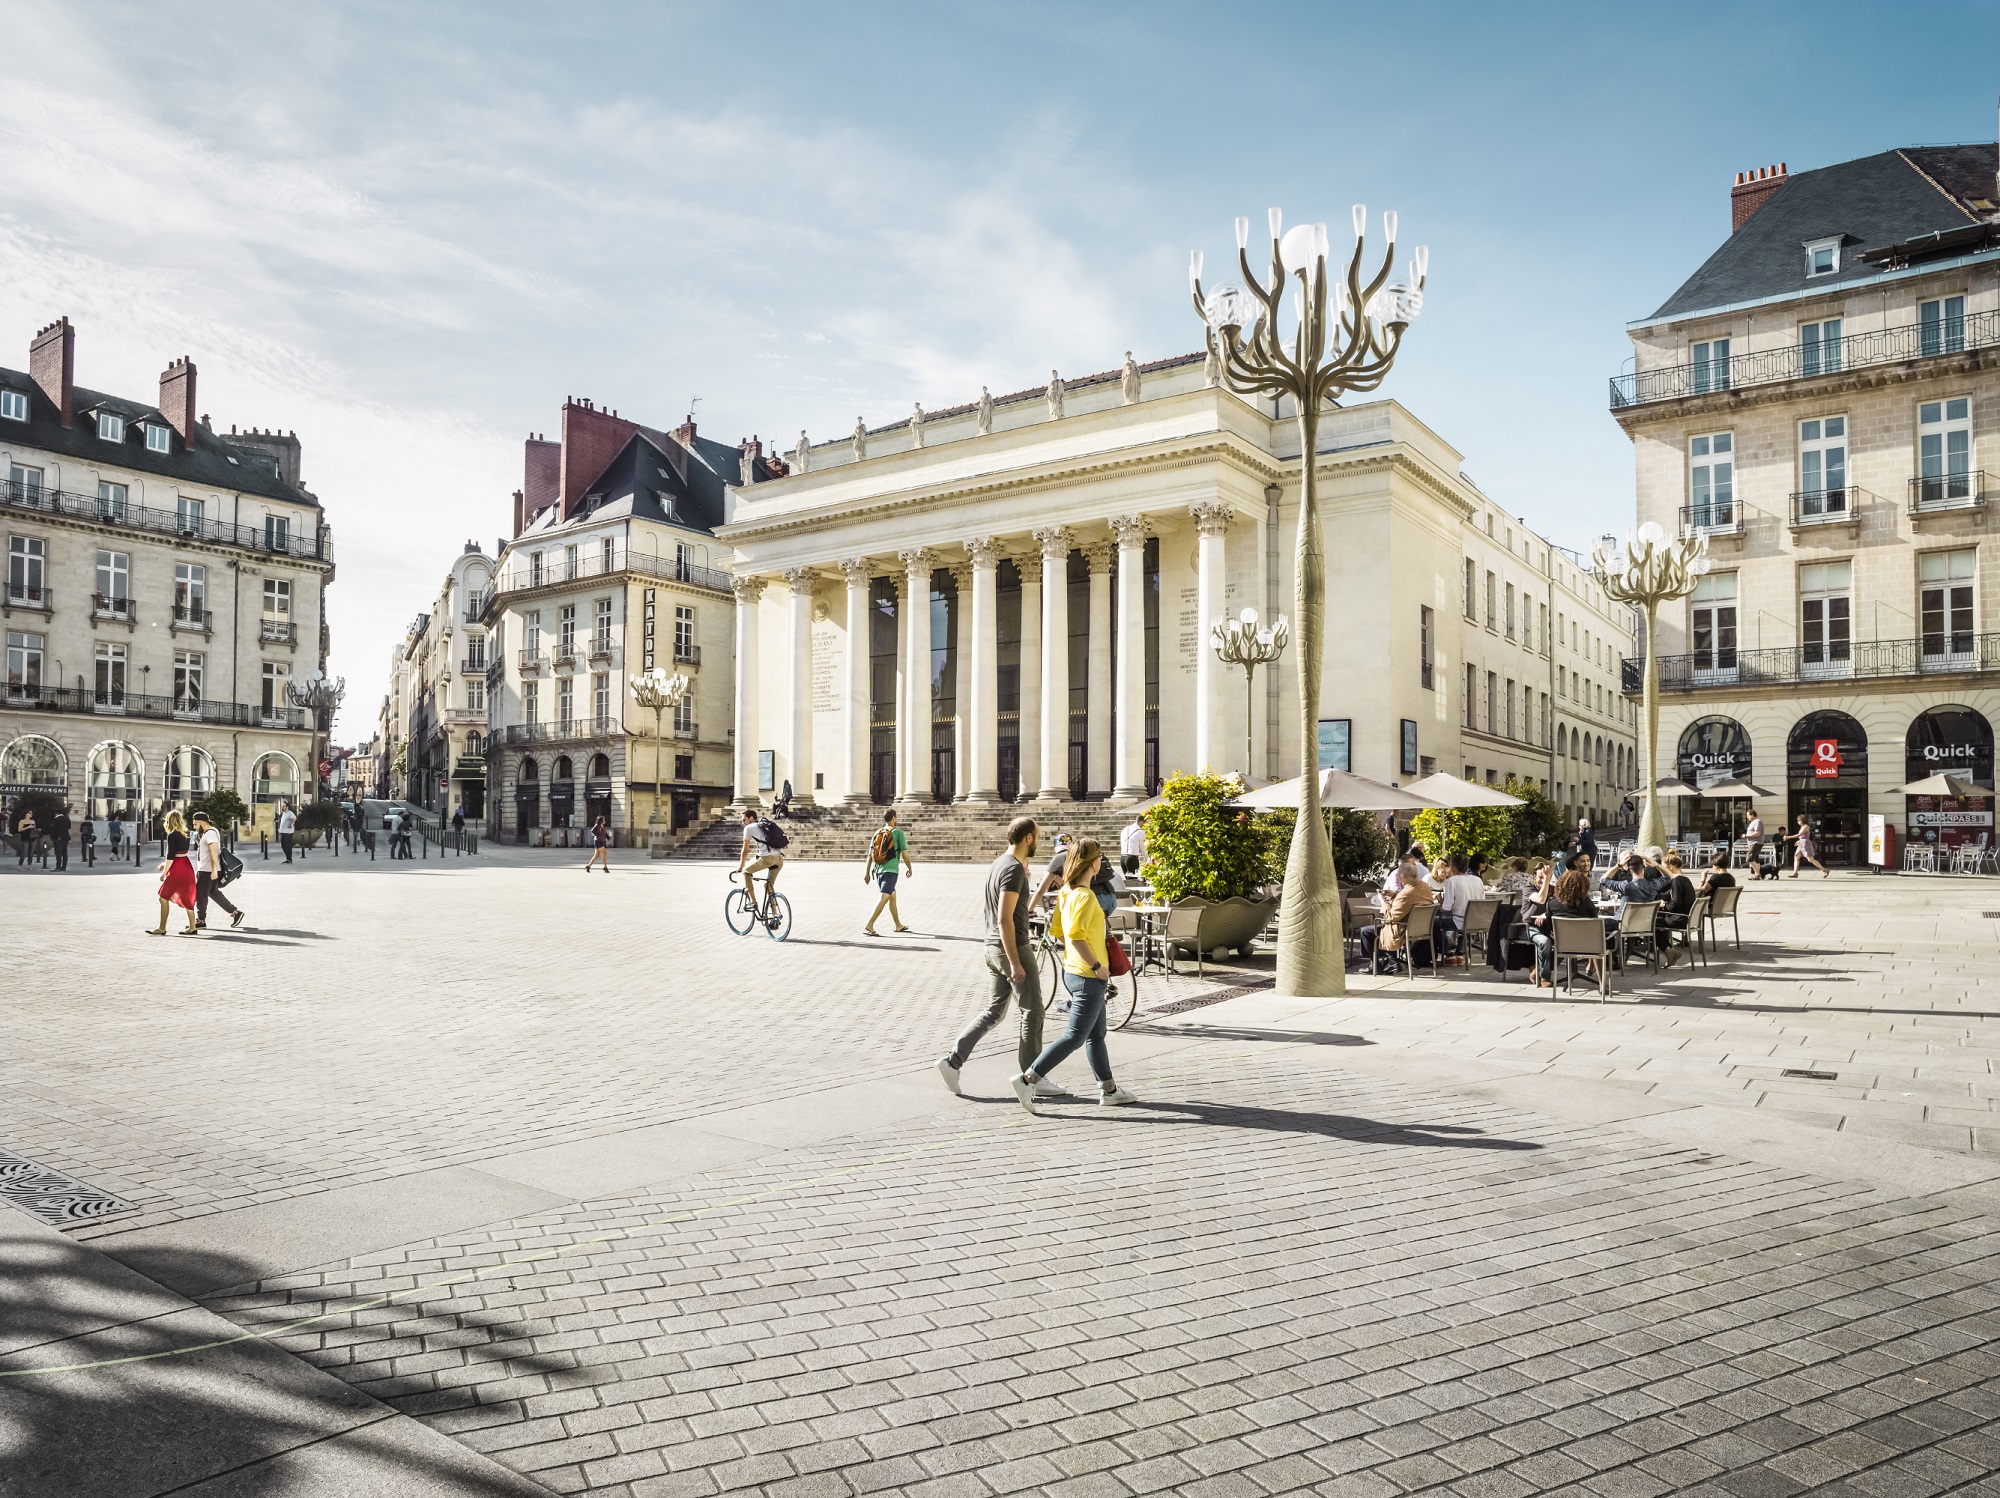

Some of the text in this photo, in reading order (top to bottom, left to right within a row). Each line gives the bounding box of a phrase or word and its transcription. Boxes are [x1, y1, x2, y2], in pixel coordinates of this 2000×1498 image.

[1691, 752, 1735, 768] Quick
[1817, 743, 1837, 762] Q
[1923, 744, 1976, 761] Quick
[1816, 768, 1837, 776] Quick
